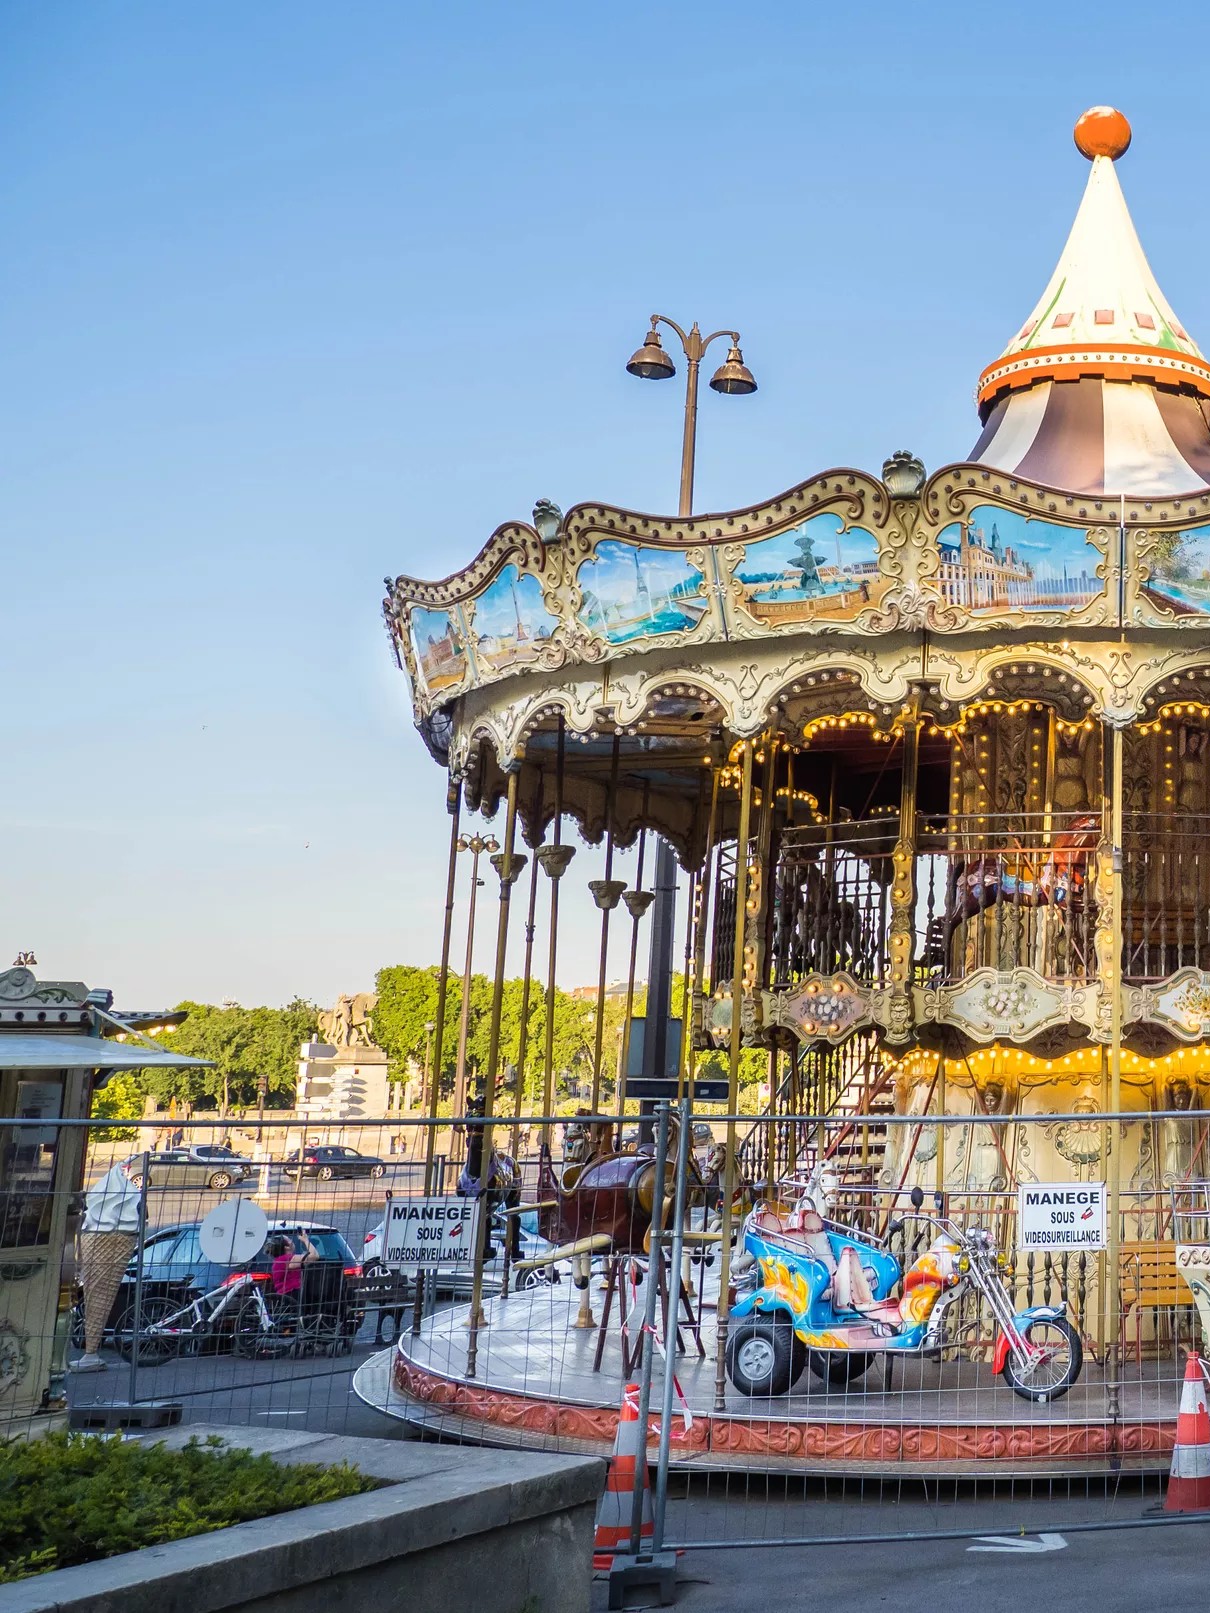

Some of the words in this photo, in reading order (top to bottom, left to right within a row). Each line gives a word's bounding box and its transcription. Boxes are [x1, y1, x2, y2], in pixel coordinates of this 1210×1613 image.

[1026, 1192, 1100, 1205] MANEGE
[392, 1206, 472, 1220] MANEGE
[1050, 1211, 1075, 1224] SOUS
[416, 1227, 443, 1240] SOUS
[1024, 1230, 1101, 1244] VIDEOSURVEILLANCE
[387, 1246, 469, 1260] VIDEOSURVEILLANCE
